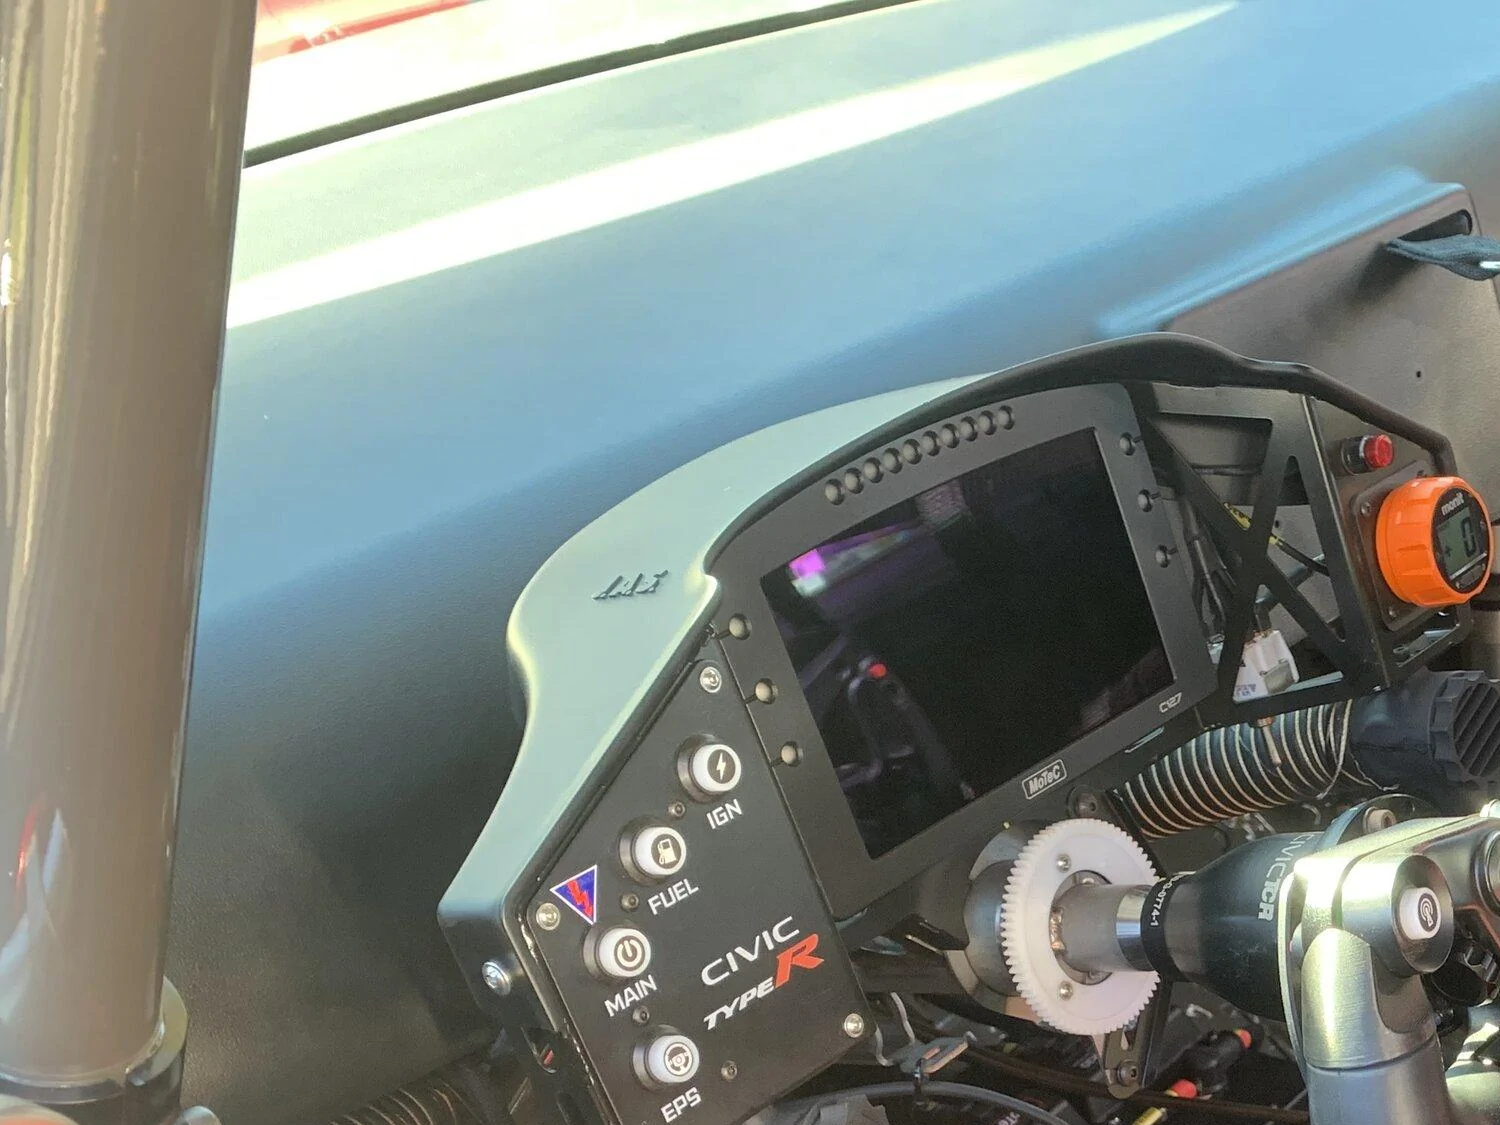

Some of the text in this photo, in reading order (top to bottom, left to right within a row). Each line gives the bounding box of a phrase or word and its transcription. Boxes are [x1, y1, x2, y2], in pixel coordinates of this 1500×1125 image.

[1159, 692, 1183, 713] C127
[1027, 764, 1061, 794] MoTeC
[706, 799, 742, 830] IGN
[1258, 834, 1315, 921] CIVIC TCR
[648, 878, 700, 916] FUEL
[701, 916, 800, 986] CIVIC
[604, 974, 658, 1017] MAIN
[703, 933, 825, 1031] TYPE R
[660, 1086, 702, 1123] EPS
